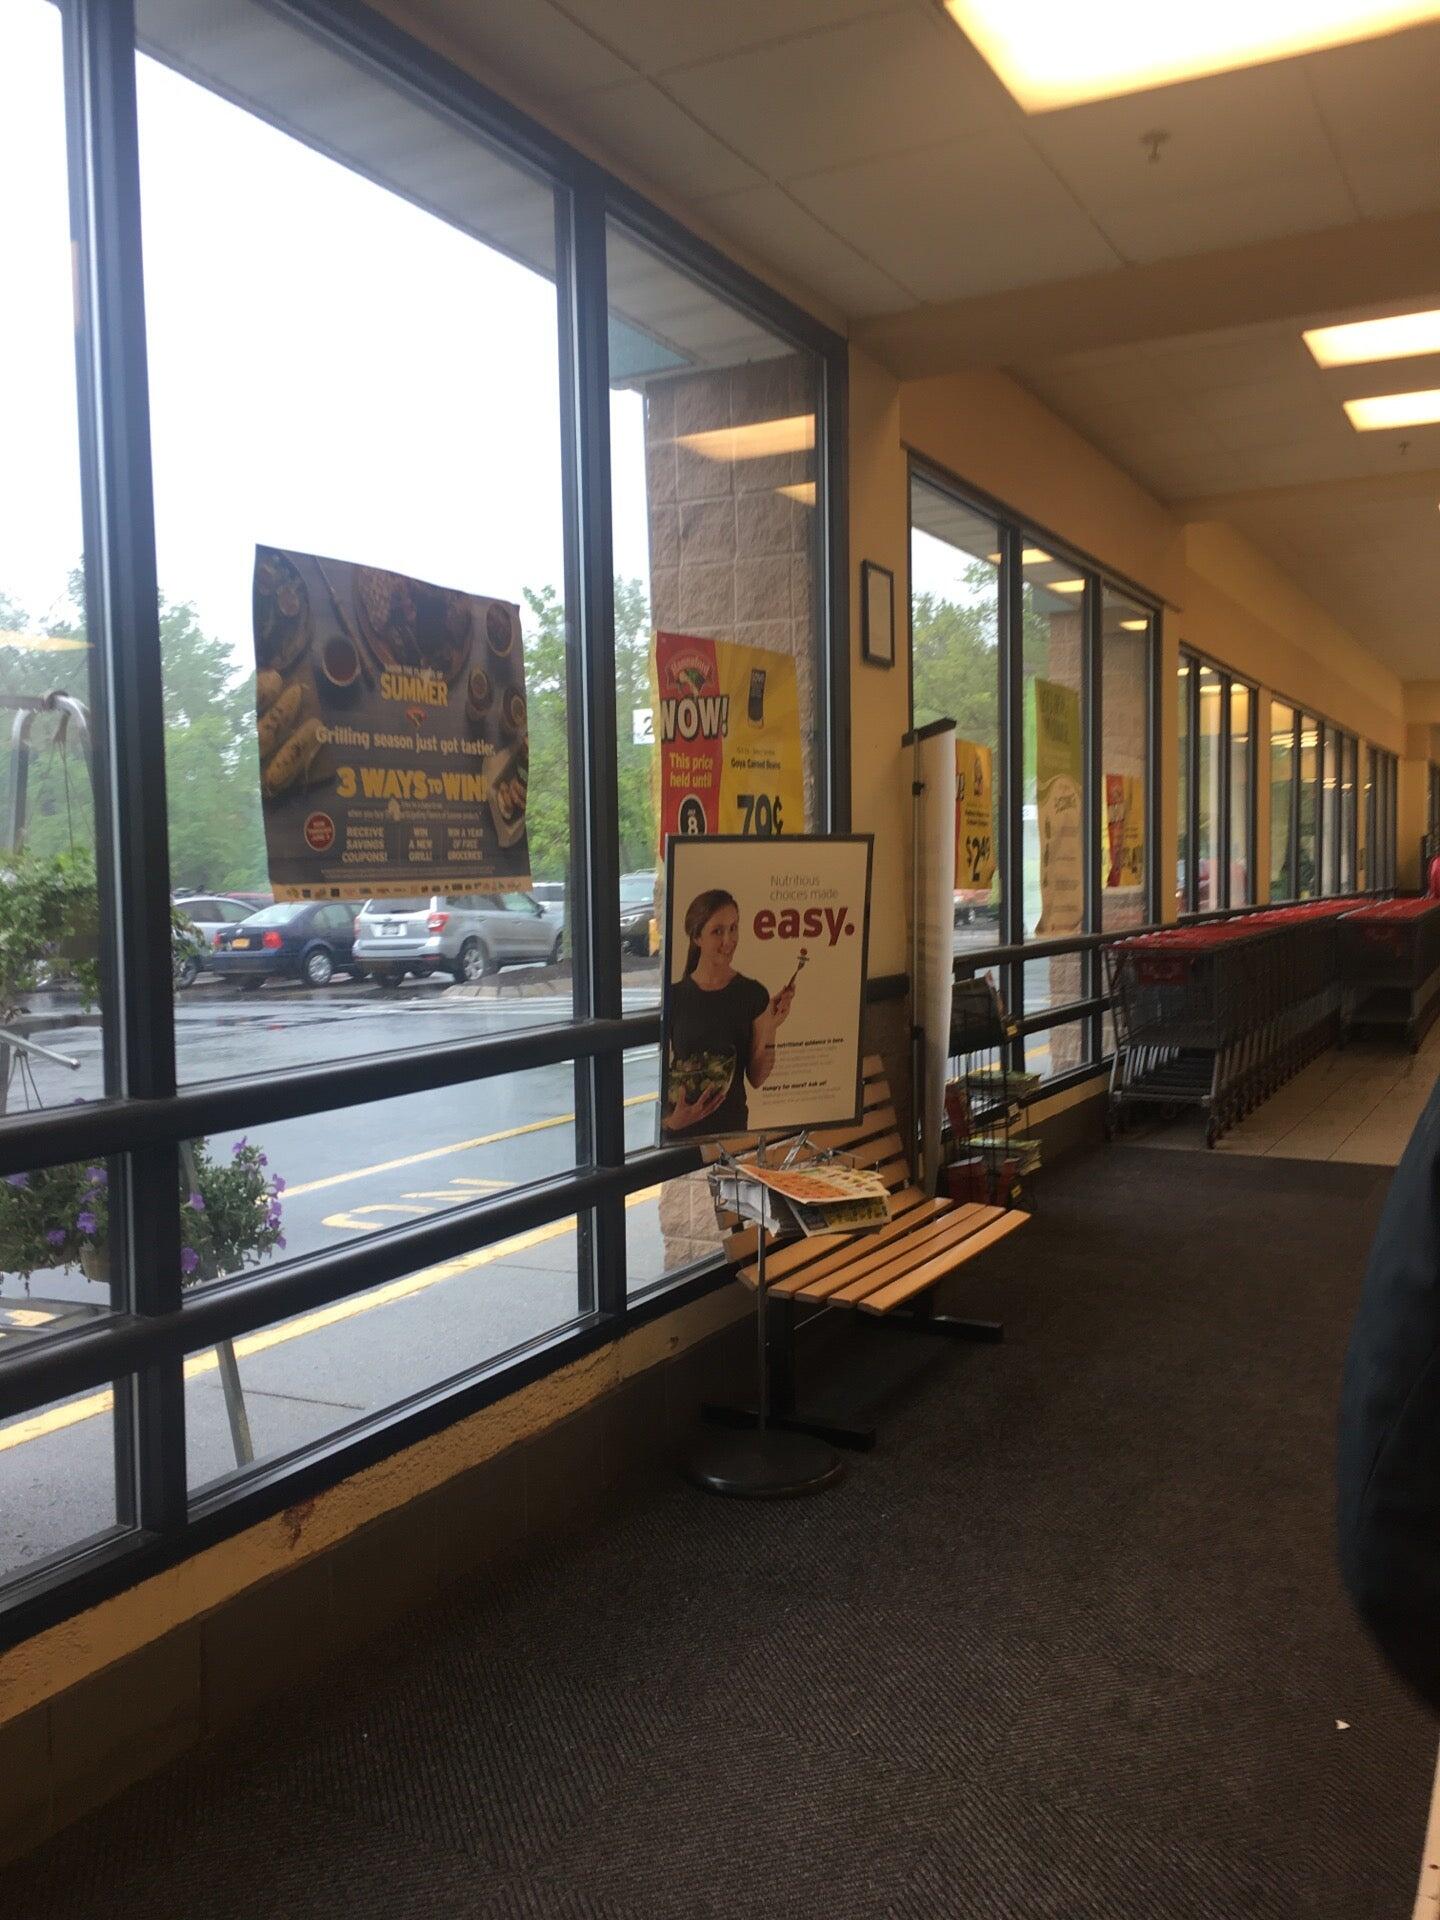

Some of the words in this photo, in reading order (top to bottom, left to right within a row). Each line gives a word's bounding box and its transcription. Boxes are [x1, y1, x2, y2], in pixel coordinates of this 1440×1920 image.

[381, 671, 449, 707] SUMMER
[660, 696, 729, 741] NOW!
[315, 725, 370, 750] Grilling
[374, 732, 413, 749] season
[415, 733, 437, 754] just
[441, 738, 458, 755] got
[669, 752, 690, 769] This
[692, 754, 713, 771] price
[336, 767, 357, 798] 3
[360, 768, 429, 800] WAYS
[428, 778, 443, 795] TO
[441, 772, 488, 801] WIN!
[670, 771, 690, 788] held
[692, 772, 713, 788] until
[688, 816, 699, 835] 8
[770, 874, 820, 886] Nutritious
[769, 889, 808, 901] choices
[810, 888, 839, 899] made
[753, 907, 855, 946] easy.
